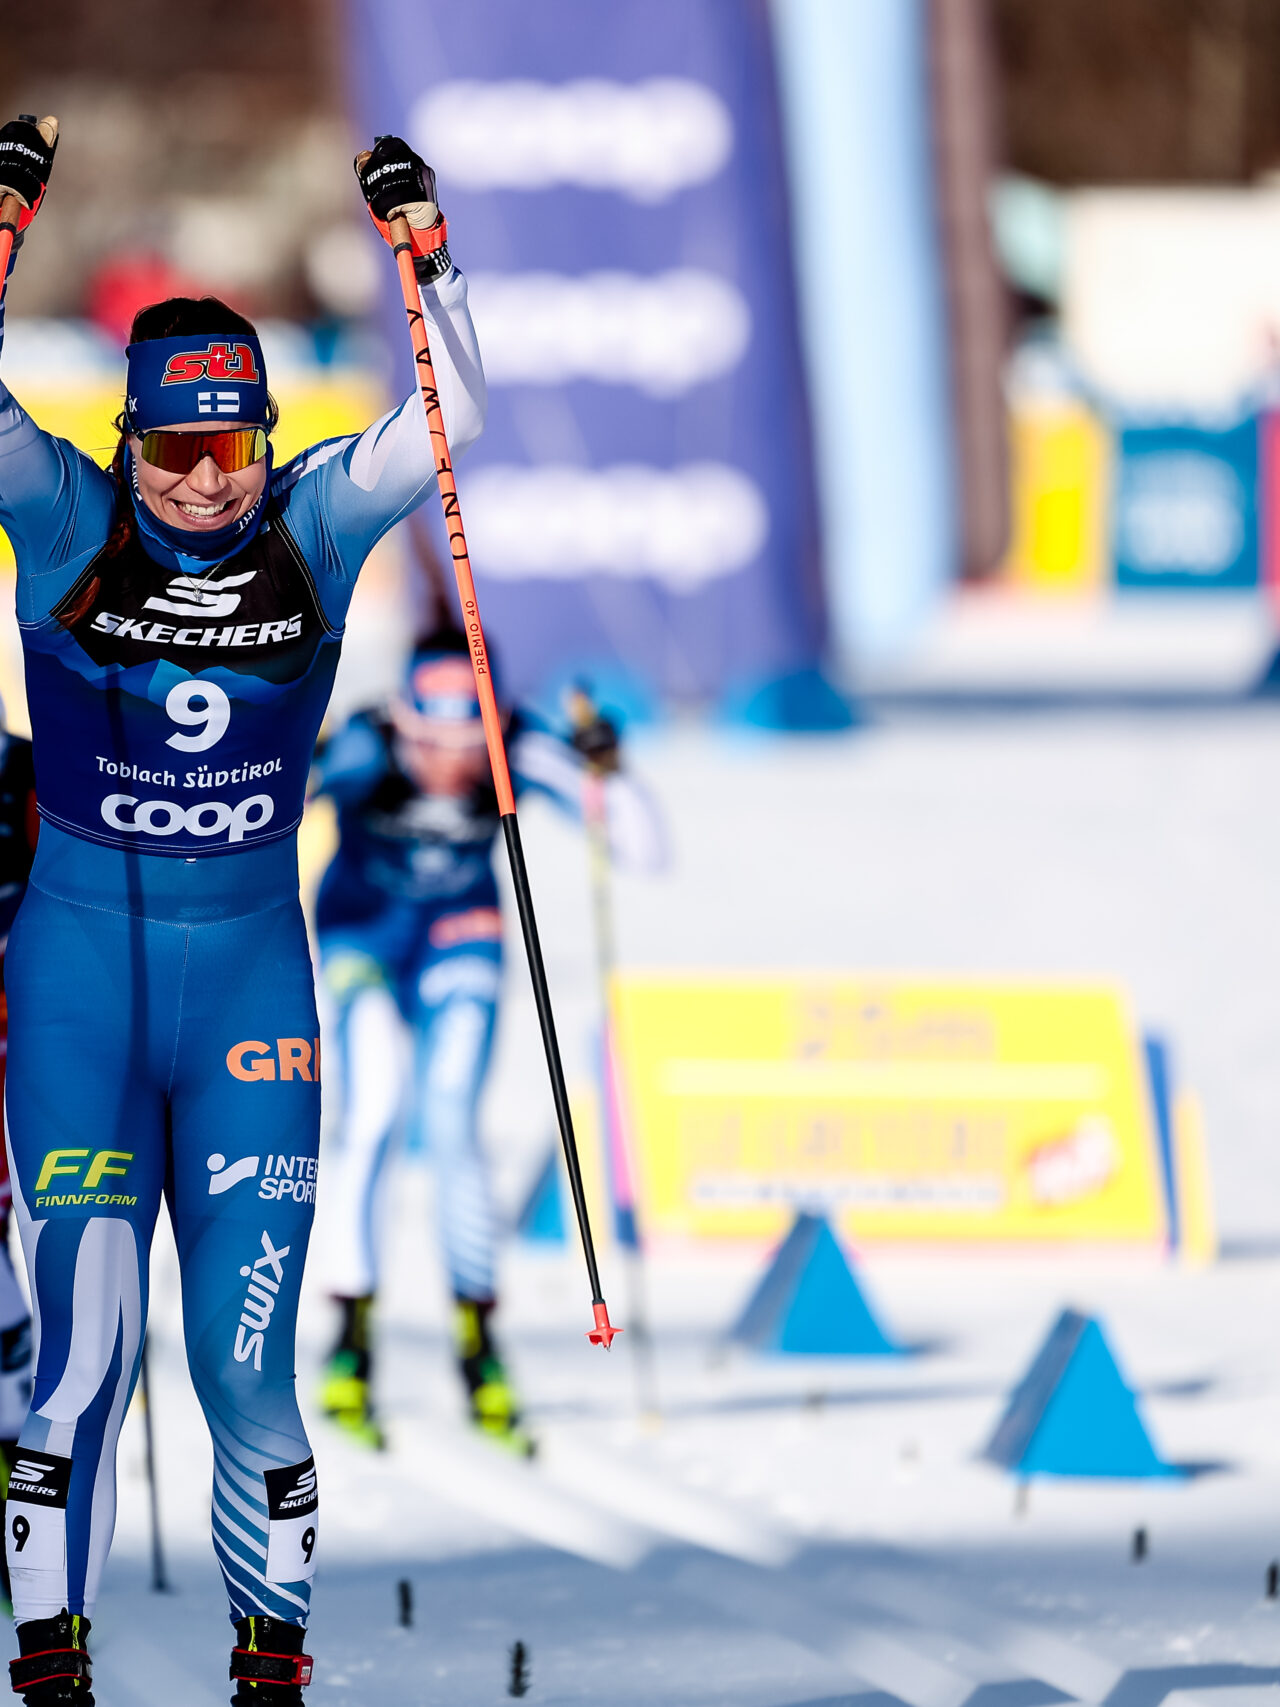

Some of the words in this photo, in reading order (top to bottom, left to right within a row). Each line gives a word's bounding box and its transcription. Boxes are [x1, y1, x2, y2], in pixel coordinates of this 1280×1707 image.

[465, 600, 475, 616] 40
[90, 612, 303, 647] SKECHERS
[470, 623, 487, 675] PREMIO
[165, 680, 231, 753] 9
[96, 755, 176, 787] Toblach
[100, 793, 274, 842] coop
[35, 1148, 135, 1192] FF
[36, 1193, 138, 1208] FINNFORM
[12, 1514, 30, 1552] 9
[301, 1526, 316, 1564] 9
